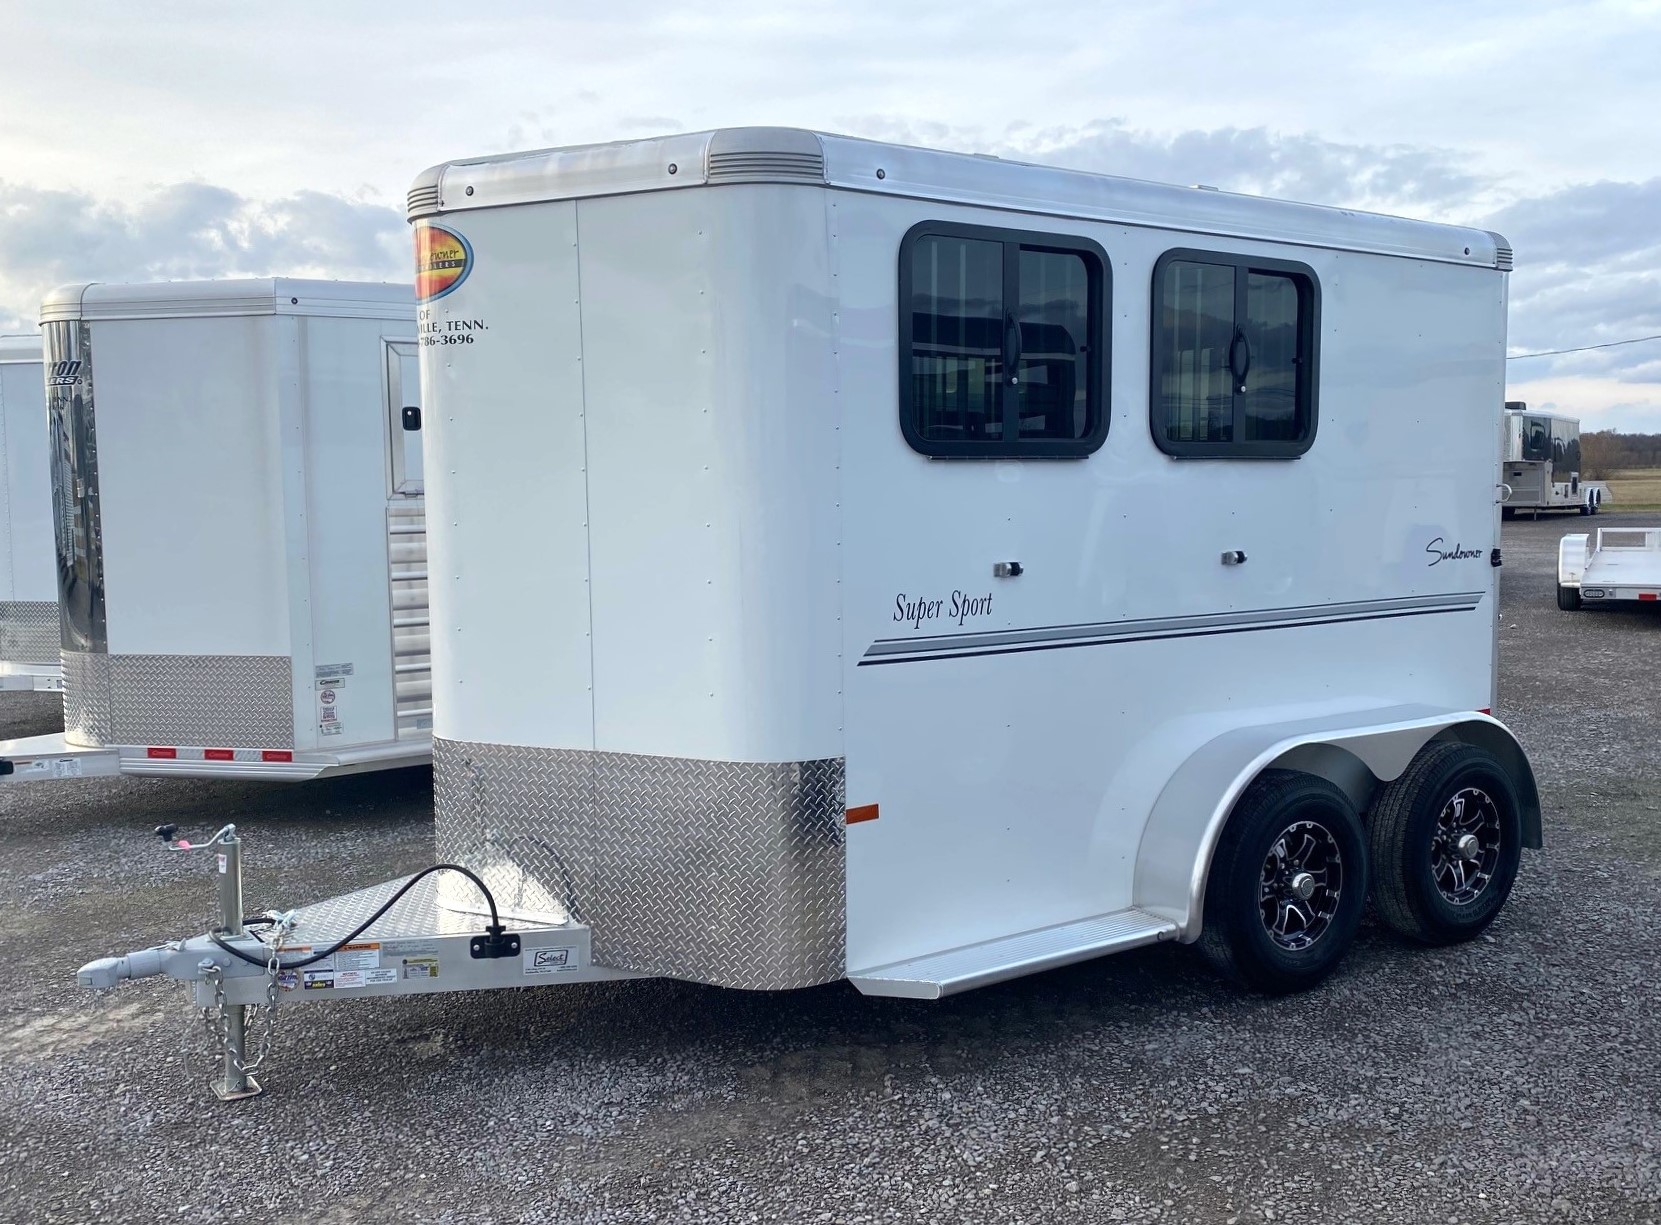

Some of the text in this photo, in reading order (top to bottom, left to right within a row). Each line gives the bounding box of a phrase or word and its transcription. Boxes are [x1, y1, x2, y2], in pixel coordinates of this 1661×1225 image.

[419, 309, 431, 321] OF
[446, 319, 489, 332] TENN.
[1425, 537, 1483, 567] Sundowner
[892, 589, 993, 630] Super Sport
[537, 952, 564, 965] Select
